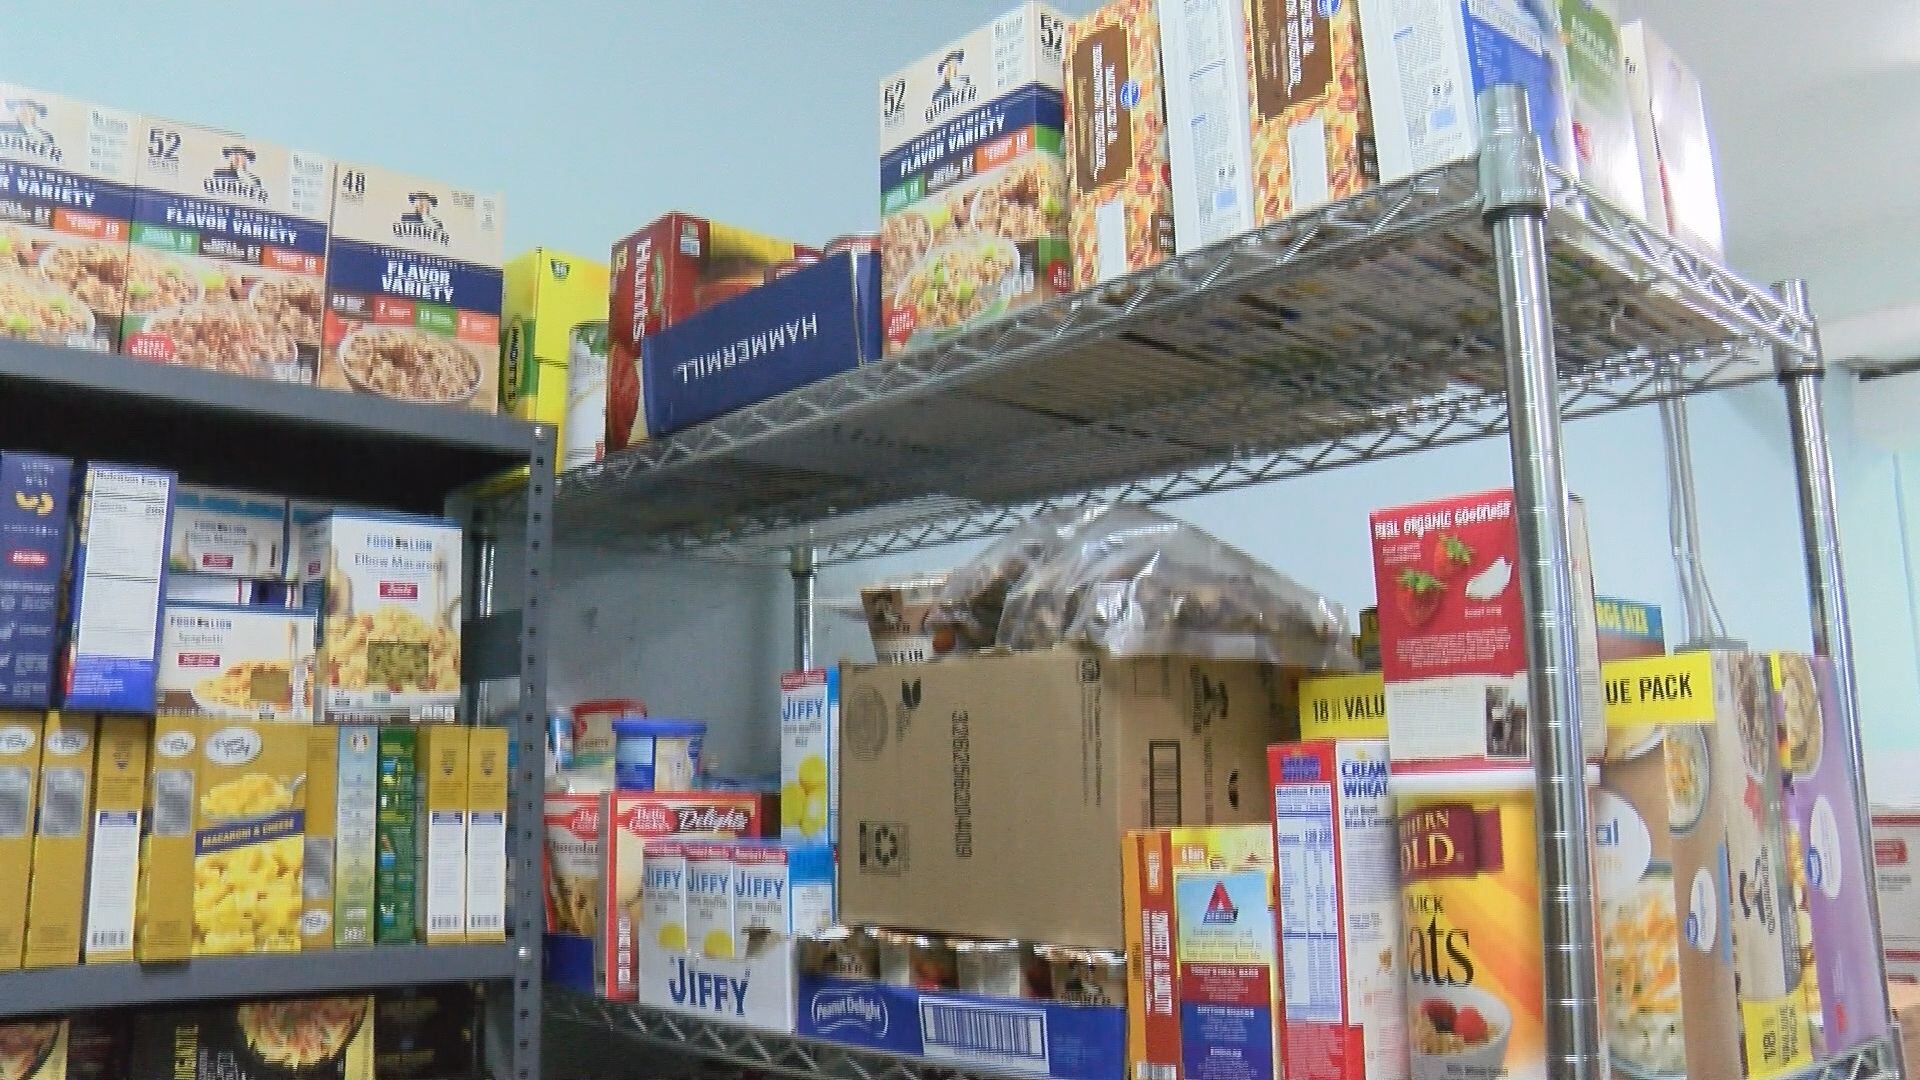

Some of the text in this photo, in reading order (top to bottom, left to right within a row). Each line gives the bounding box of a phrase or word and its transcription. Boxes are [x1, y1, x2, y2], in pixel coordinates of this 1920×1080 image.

[884, 78, 905, 118] 52
[925, 84, 977, 123] QUAKER
[0, 133, 62, 162] UAKER
[147, 126, 182, 158] 52
[900, 113, 1005, 178] FLAVOR VARIETY
[16, 179, 95, 208] VARIETY
[203, 177, 268, 205] QUAKER
[342, 170, 365, 194] 48
[166, 205, 297, 244] FLAVOR VARIETY
[392, 221, 450, 247] QUAKER
[386, 260, 451, 284] FLAVOR
[381, 275, 454, 304] VARIETY
[673, 312, 818, 384] HAMMERMILL
[366, 535, 433, 552] FOOD LION
[354, 552, 388, 567] Elbow
[170, 615, 233, 631] FOOD LION
[1640, 672, 1693, 701] PACK
[783, 696, 823, 722] JIFFY
[1312, 699, 1330, 725] 18
[1344, 693, 1386, 720] VALU
[1341, 758, 1386, 778] CREAM
[629, 815, 671, 832] Crocker
[634, 805, 666, 823] Betty
[679, 804, 749, 834] Delights
[201, 825, 252, 848] MACARONI
[262, 816, 294, 835] CHEESE
[1400, 833, 1455, 877] OLD
[645, 867, 682, 890] JIFFY
[687, 866, 729, 893] JIFFY
[735, 870, 784, 899] JIFFY
[1406, 893, 1444, 915] UICK
[1409, 914, 1475, 988] ats
[816, 995, 881, 1023] Peanut Delight
